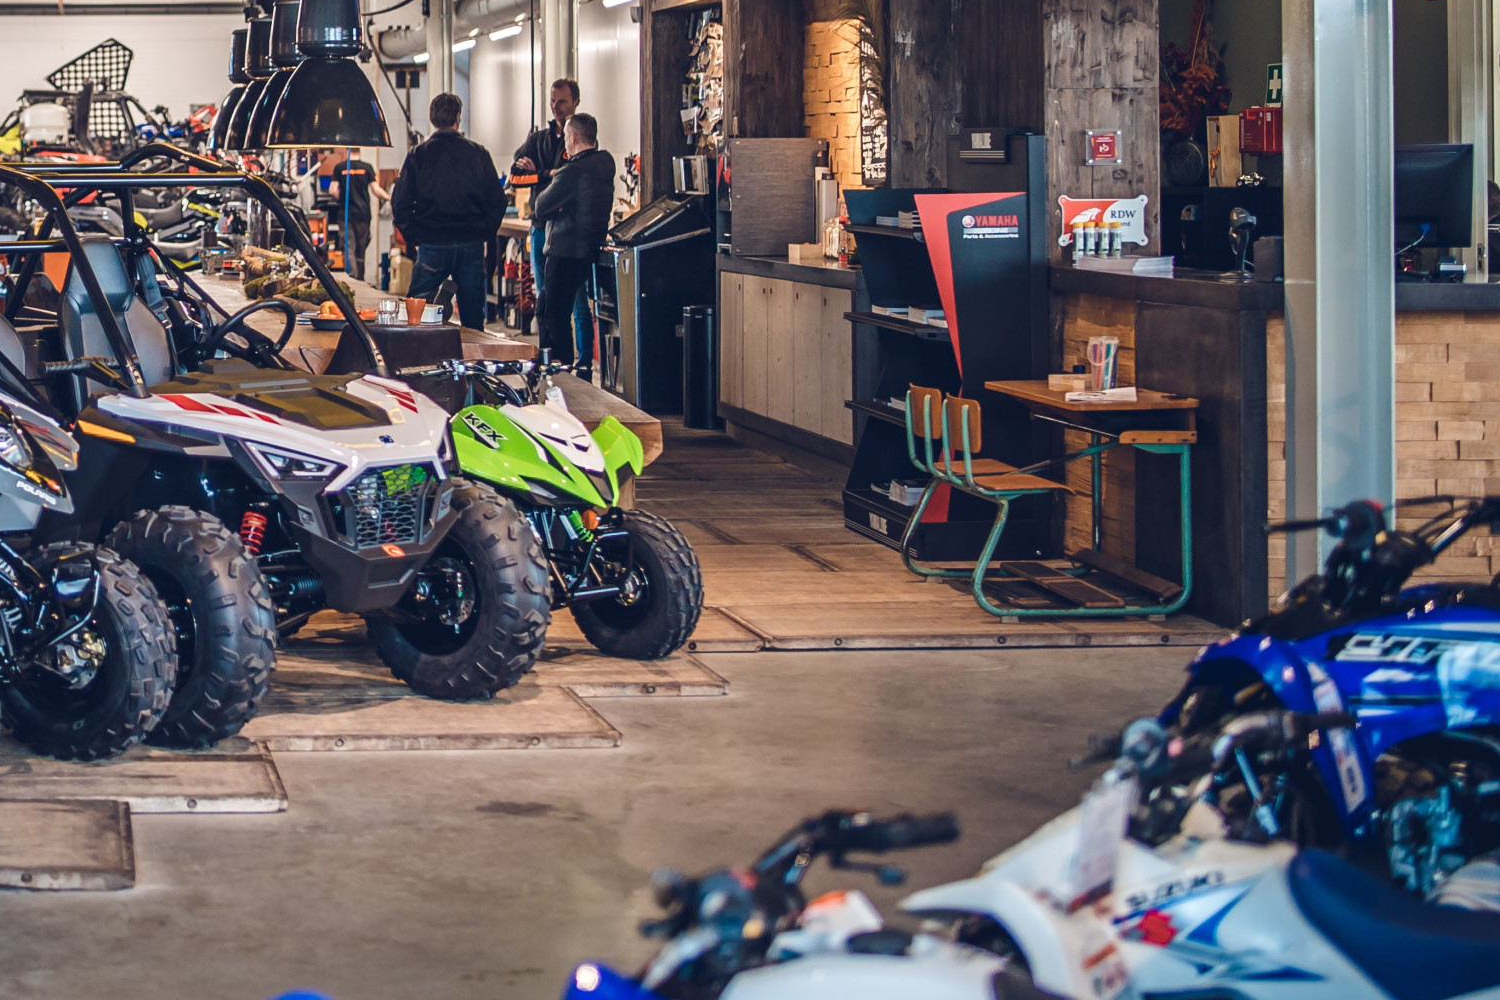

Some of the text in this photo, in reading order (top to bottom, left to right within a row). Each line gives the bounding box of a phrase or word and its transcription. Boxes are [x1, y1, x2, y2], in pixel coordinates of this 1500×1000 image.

[1110, 210, 1137, 219] RDW
[975, 215, 1019, 227] YAMAHA
[464, 412, 505, 443] KFX
